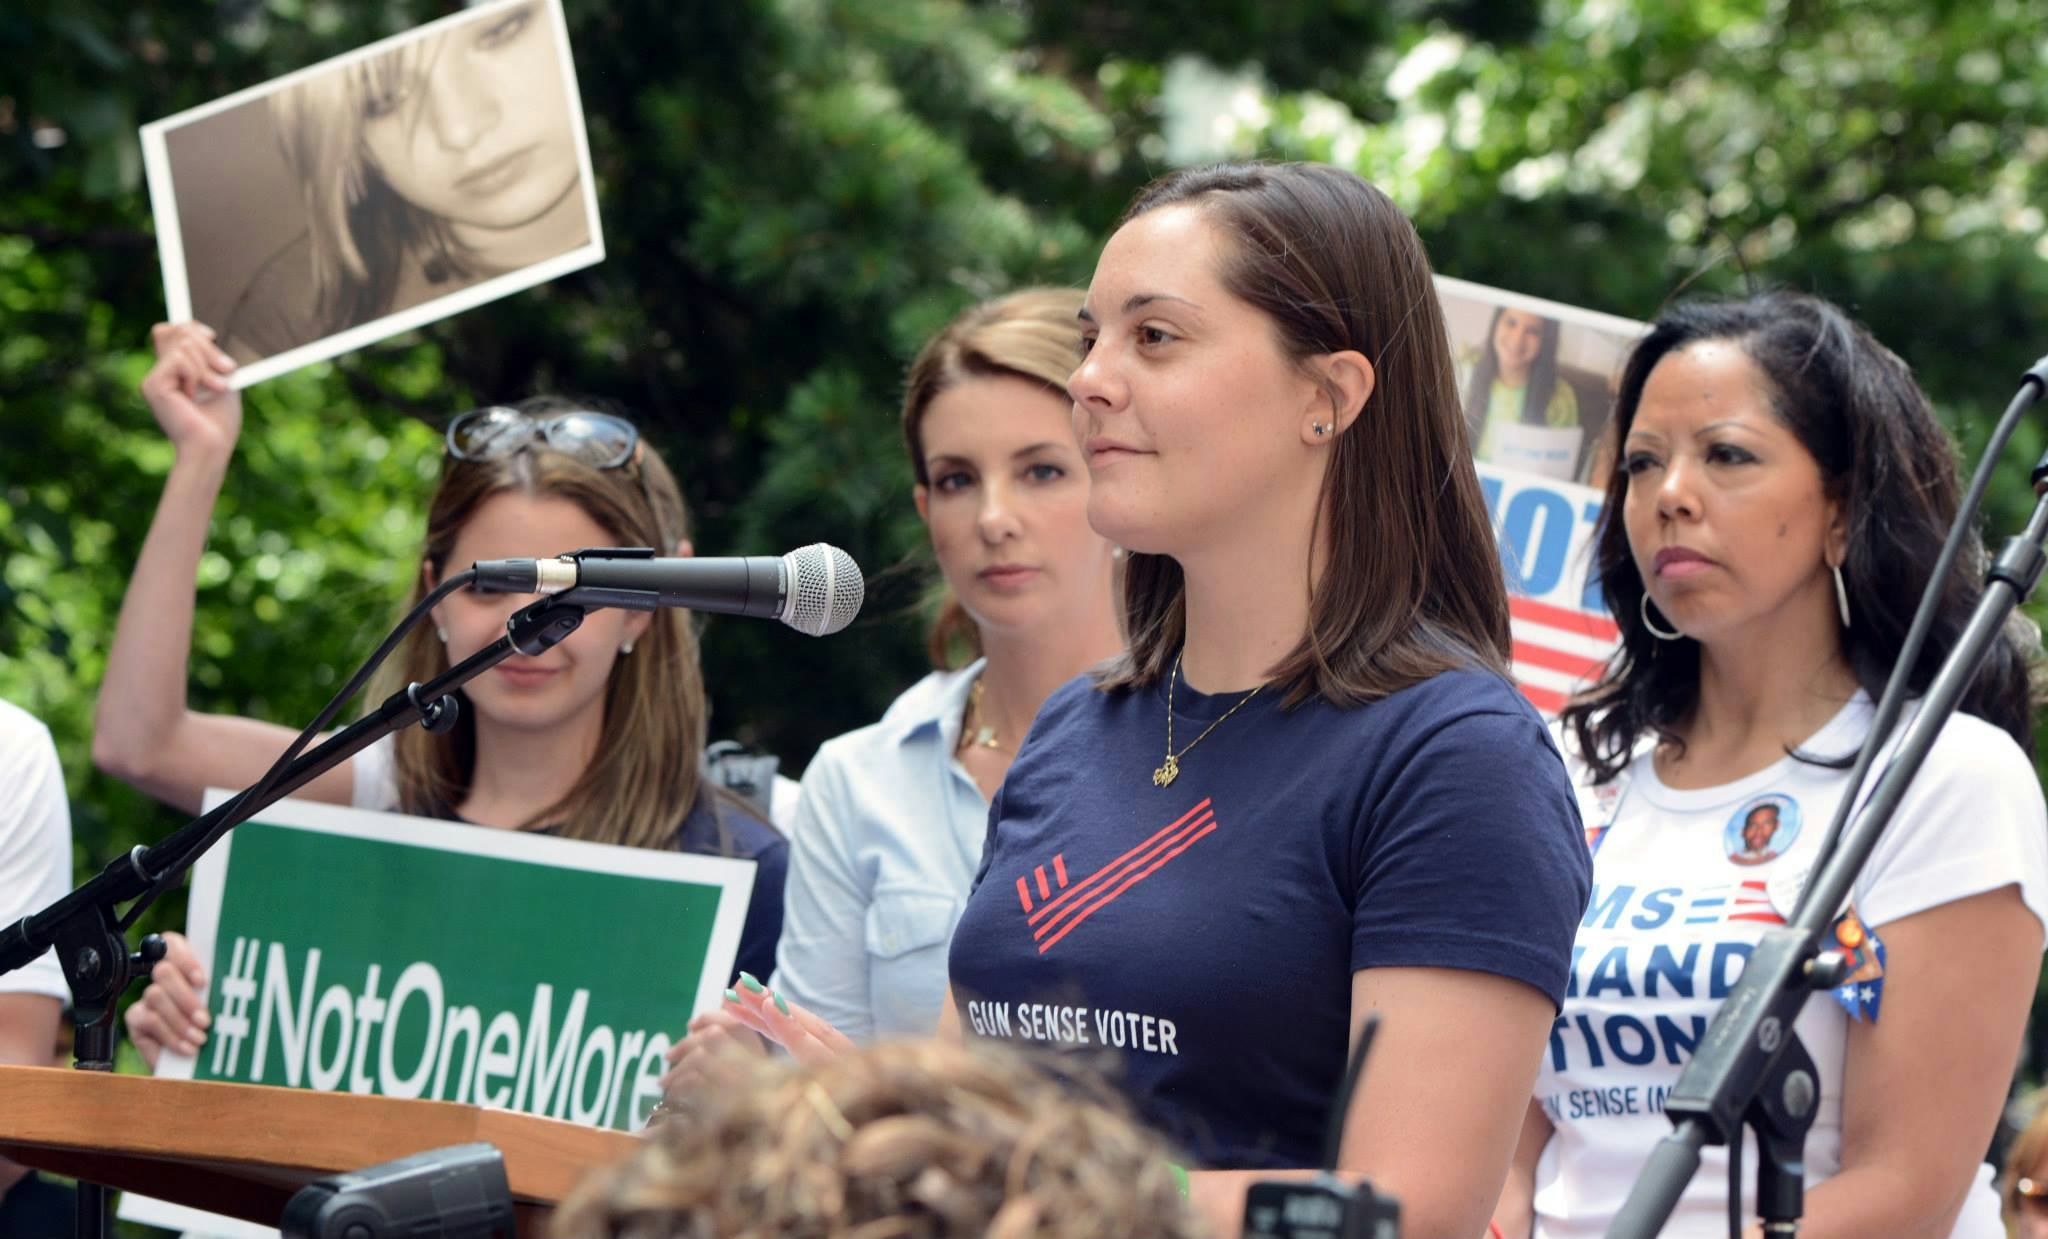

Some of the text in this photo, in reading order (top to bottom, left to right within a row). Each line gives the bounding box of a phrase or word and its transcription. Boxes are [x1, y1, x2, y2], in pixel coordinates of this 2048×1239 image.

[211, 937, 670, 1131] #NotOneMore
[968, 1000, 1179, 1056] GUN SENSE VOTER
[1569, 1086, 1639, 1119] SENSE
